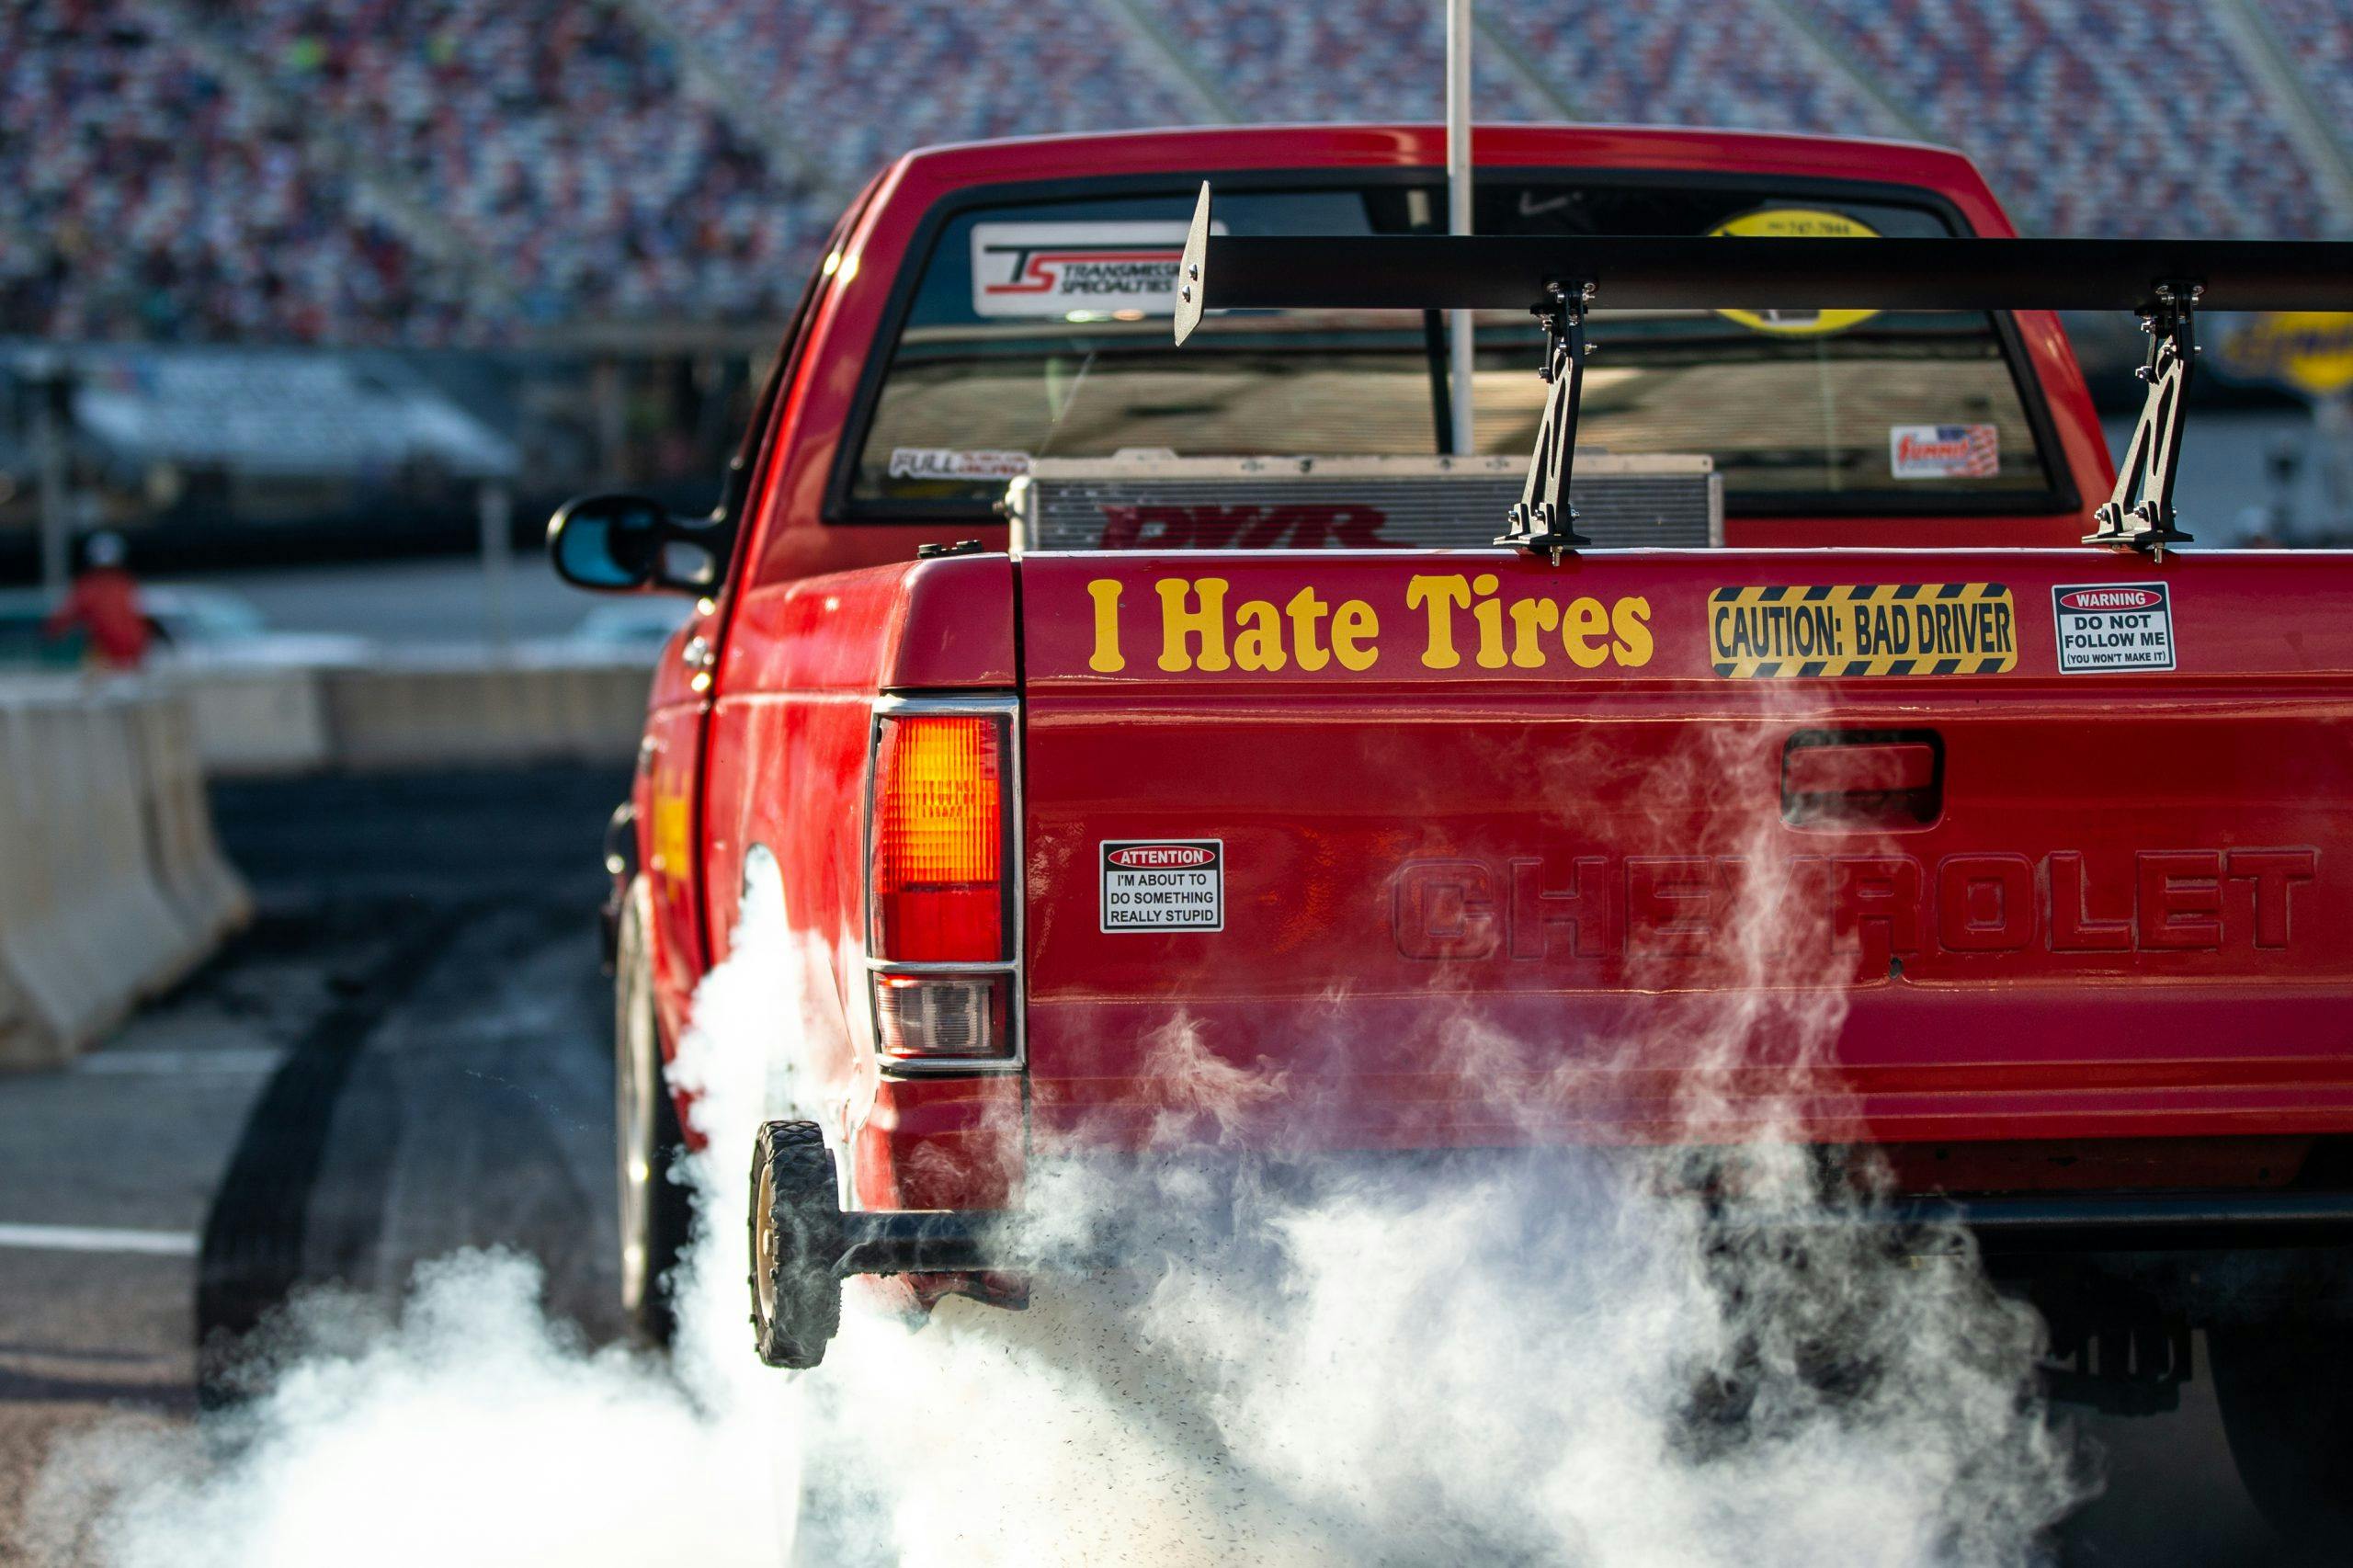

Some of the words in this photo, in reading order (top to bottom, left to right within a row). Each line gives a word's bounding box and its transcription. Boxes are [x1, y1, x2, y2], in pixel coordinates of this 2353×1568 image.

[1061, 278, 1173, 294] SPECIALTIES
[2075, 593, 2146, 608] WARNING
[1087, 578, 1126, 673] I
[1154, 577, 1380, 673] Hate
[1405, 574, 1654, 669] Tires
[1714, 605, 1843, 658] CAUTION:
[1853, 603, 1910, 656] BAD
[1915, 602, 2012, 654] DRIVER
[2074, 616, 2103, 631] DO
[2109, 614, 2151, 630] NOT
[2064, 632, 2135, 649] FOLLOW
[2140, 631, 2165, 646] ME
[2067, 653, 2089, 665] (YOU
[2092, 653, 2122, 664] WON'T
[2125, 652, 2151, 662] MAKE
[2154, 651, 2166, 662] IT)
[1120, 850, 1204, 864] ATTENTION
[1117, 874, 1135, 886] I'M
[1138, 874, 1185, 886] ABOUT
[1188, 873, 1207, 885] TO
[1110, 892, 1131, 904] DO
[1133, 892, 1213, 904] SOMETHING
[1392, 846, 2320, 961] CHEVROLET
[1110, 910, 1162, 923] REALLY
[1165, 909, 1213, 922] STUPID
